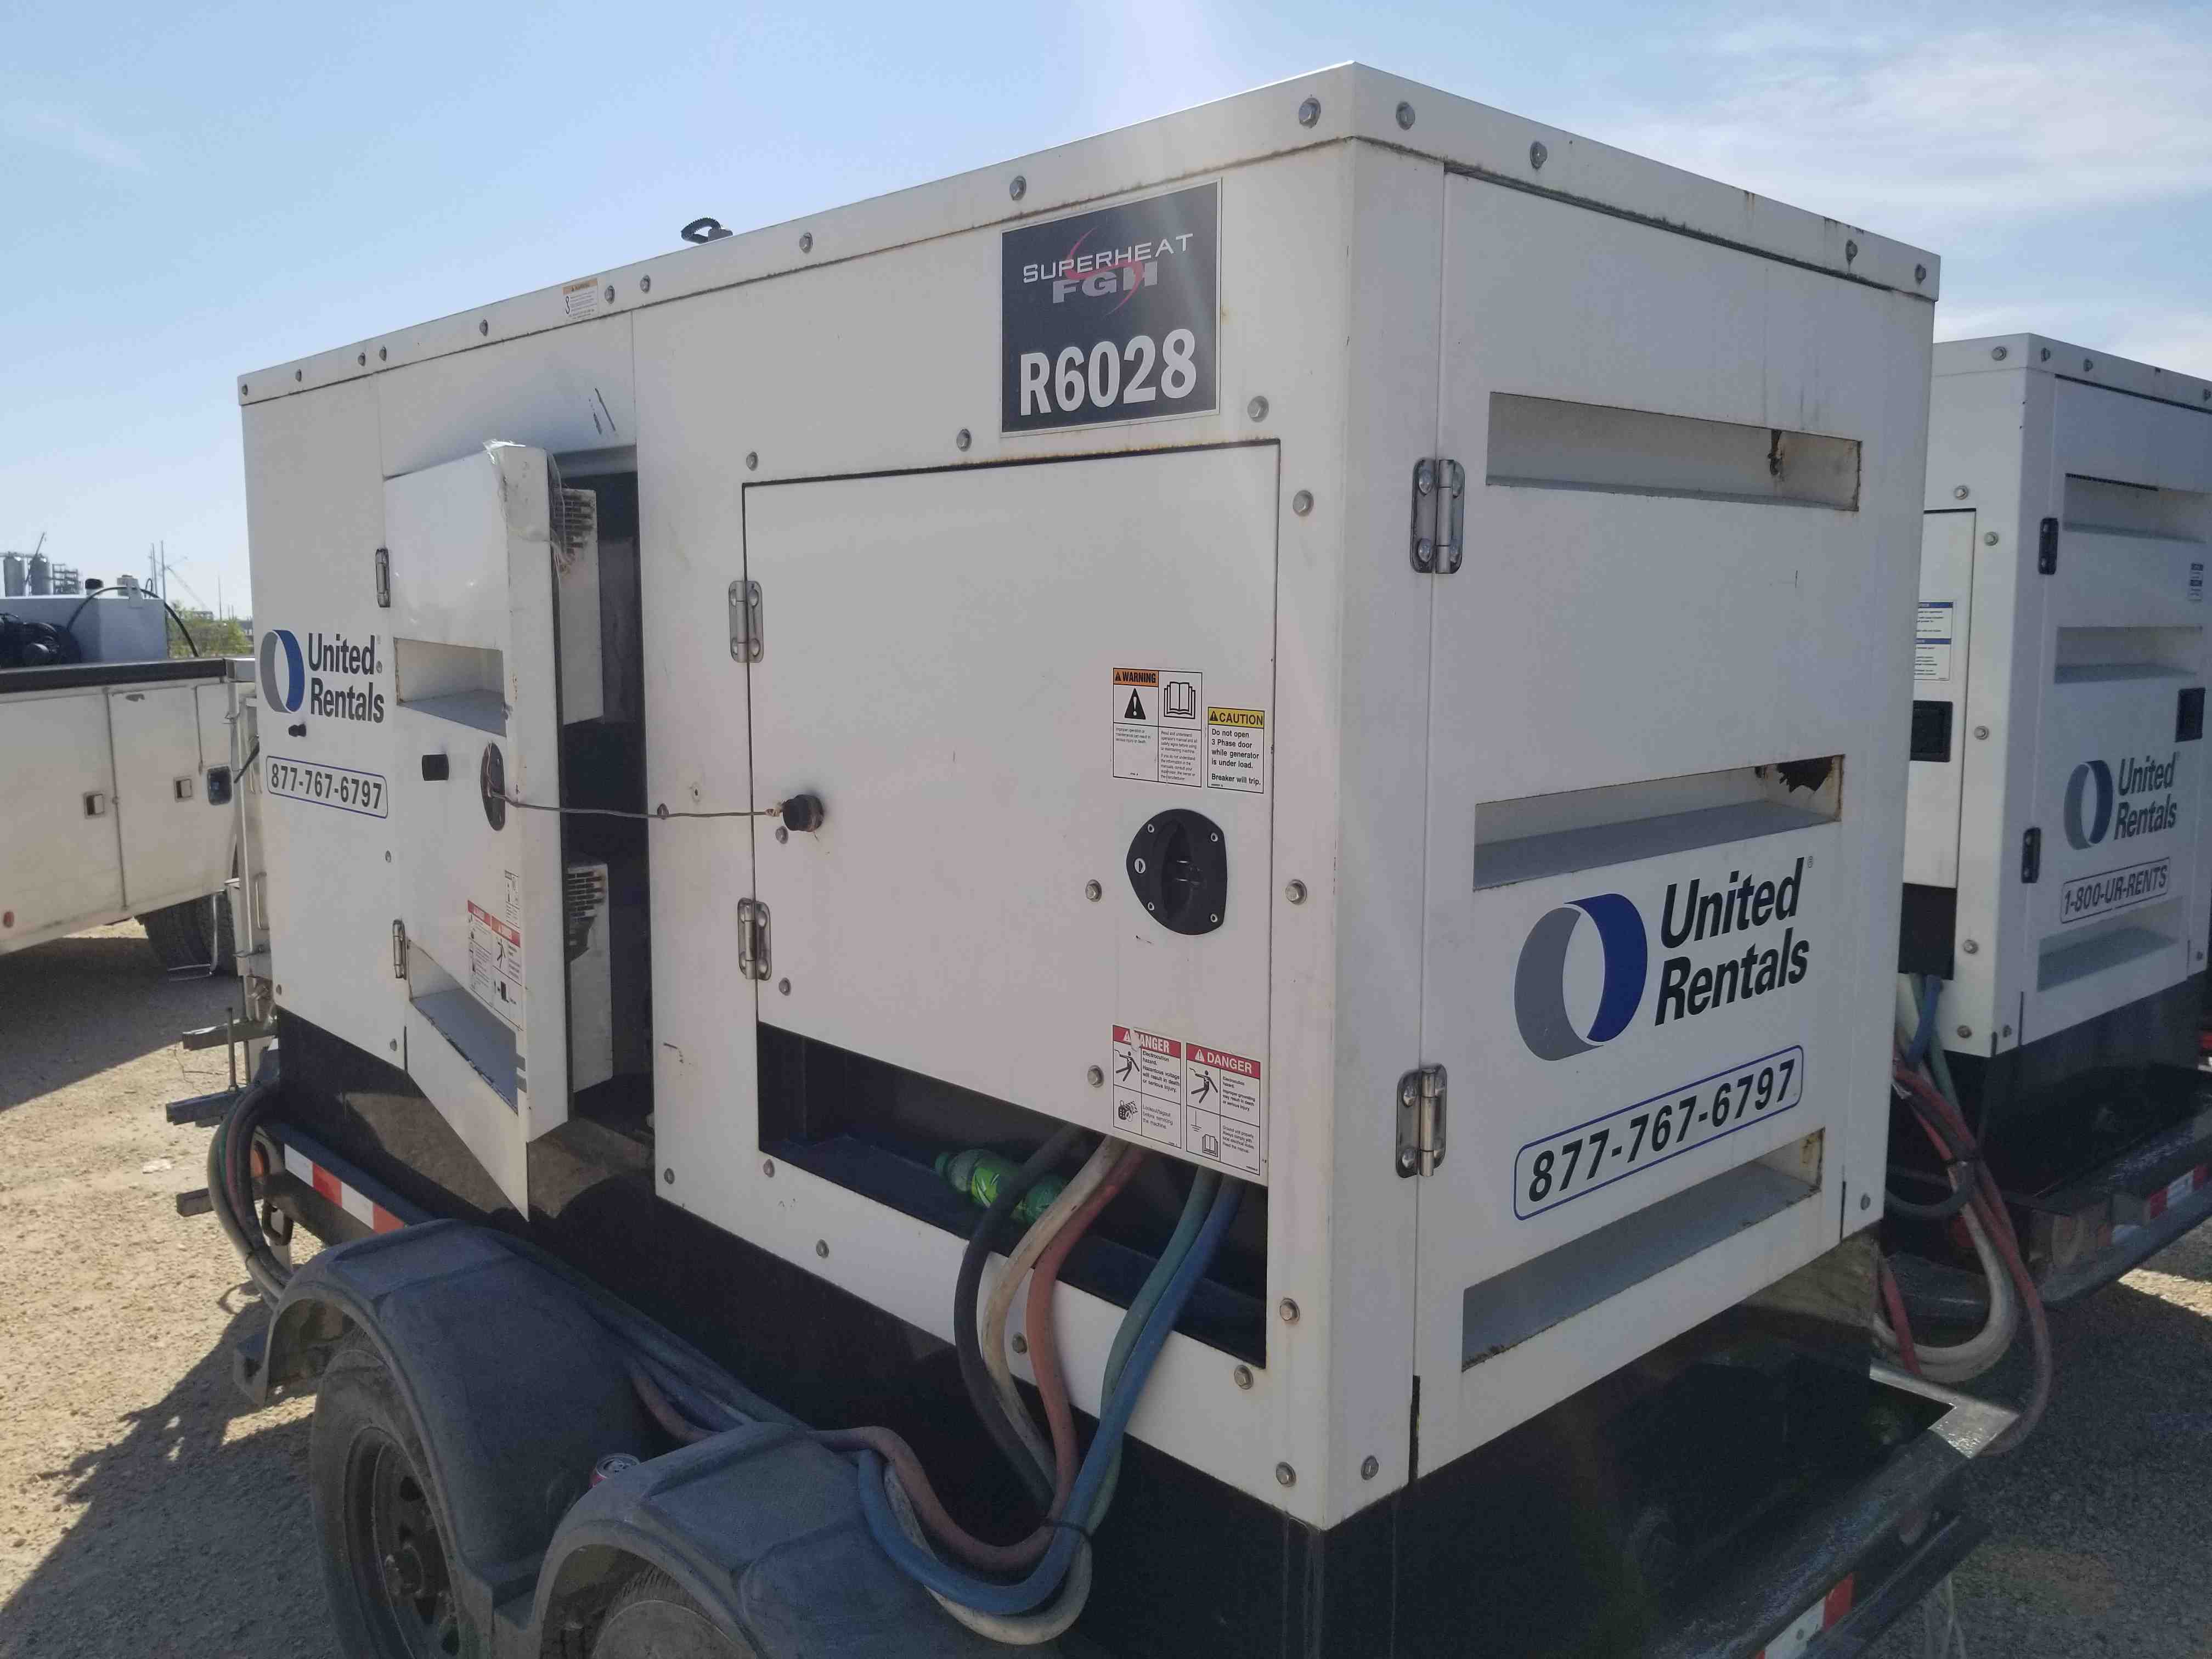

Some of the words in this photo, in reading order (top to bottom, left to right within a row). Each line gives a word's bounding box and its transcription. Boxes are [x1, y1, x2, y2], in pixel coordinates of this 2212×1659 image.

[1023, 233, 1193, 284] SUPERHEAT
[1020, 329, 1197, 416] R6028
[308, 633, 375, 675] United
[1122, 671, 1156, 683] WARNING
[311, 678, 385, 723] Rentals
[1219, 712, 1263, 725] CAUTION
[1229, 751, 1259, 759] generator
[2118, 751, 2177, 795] United
[271, 763, 382, 810] 877-767-6797
[1211, 773, 1234, 782] Breaker
[1249, 777, 1261, 786] trip.
[2114, 793, 2177, 840] Rentals
[1661, 856, 1804, 949] United
[2064, 864, 2168, 916] 1-800-UR-RENTS
[1655, 927, 1809, 1026] Rentals
[1133, 1032, 1170, 1053] ANGER
[1207, 1052, 1252, 1074] DANGER
[1528, 1058, 1795, 1203] 877-767-6797
